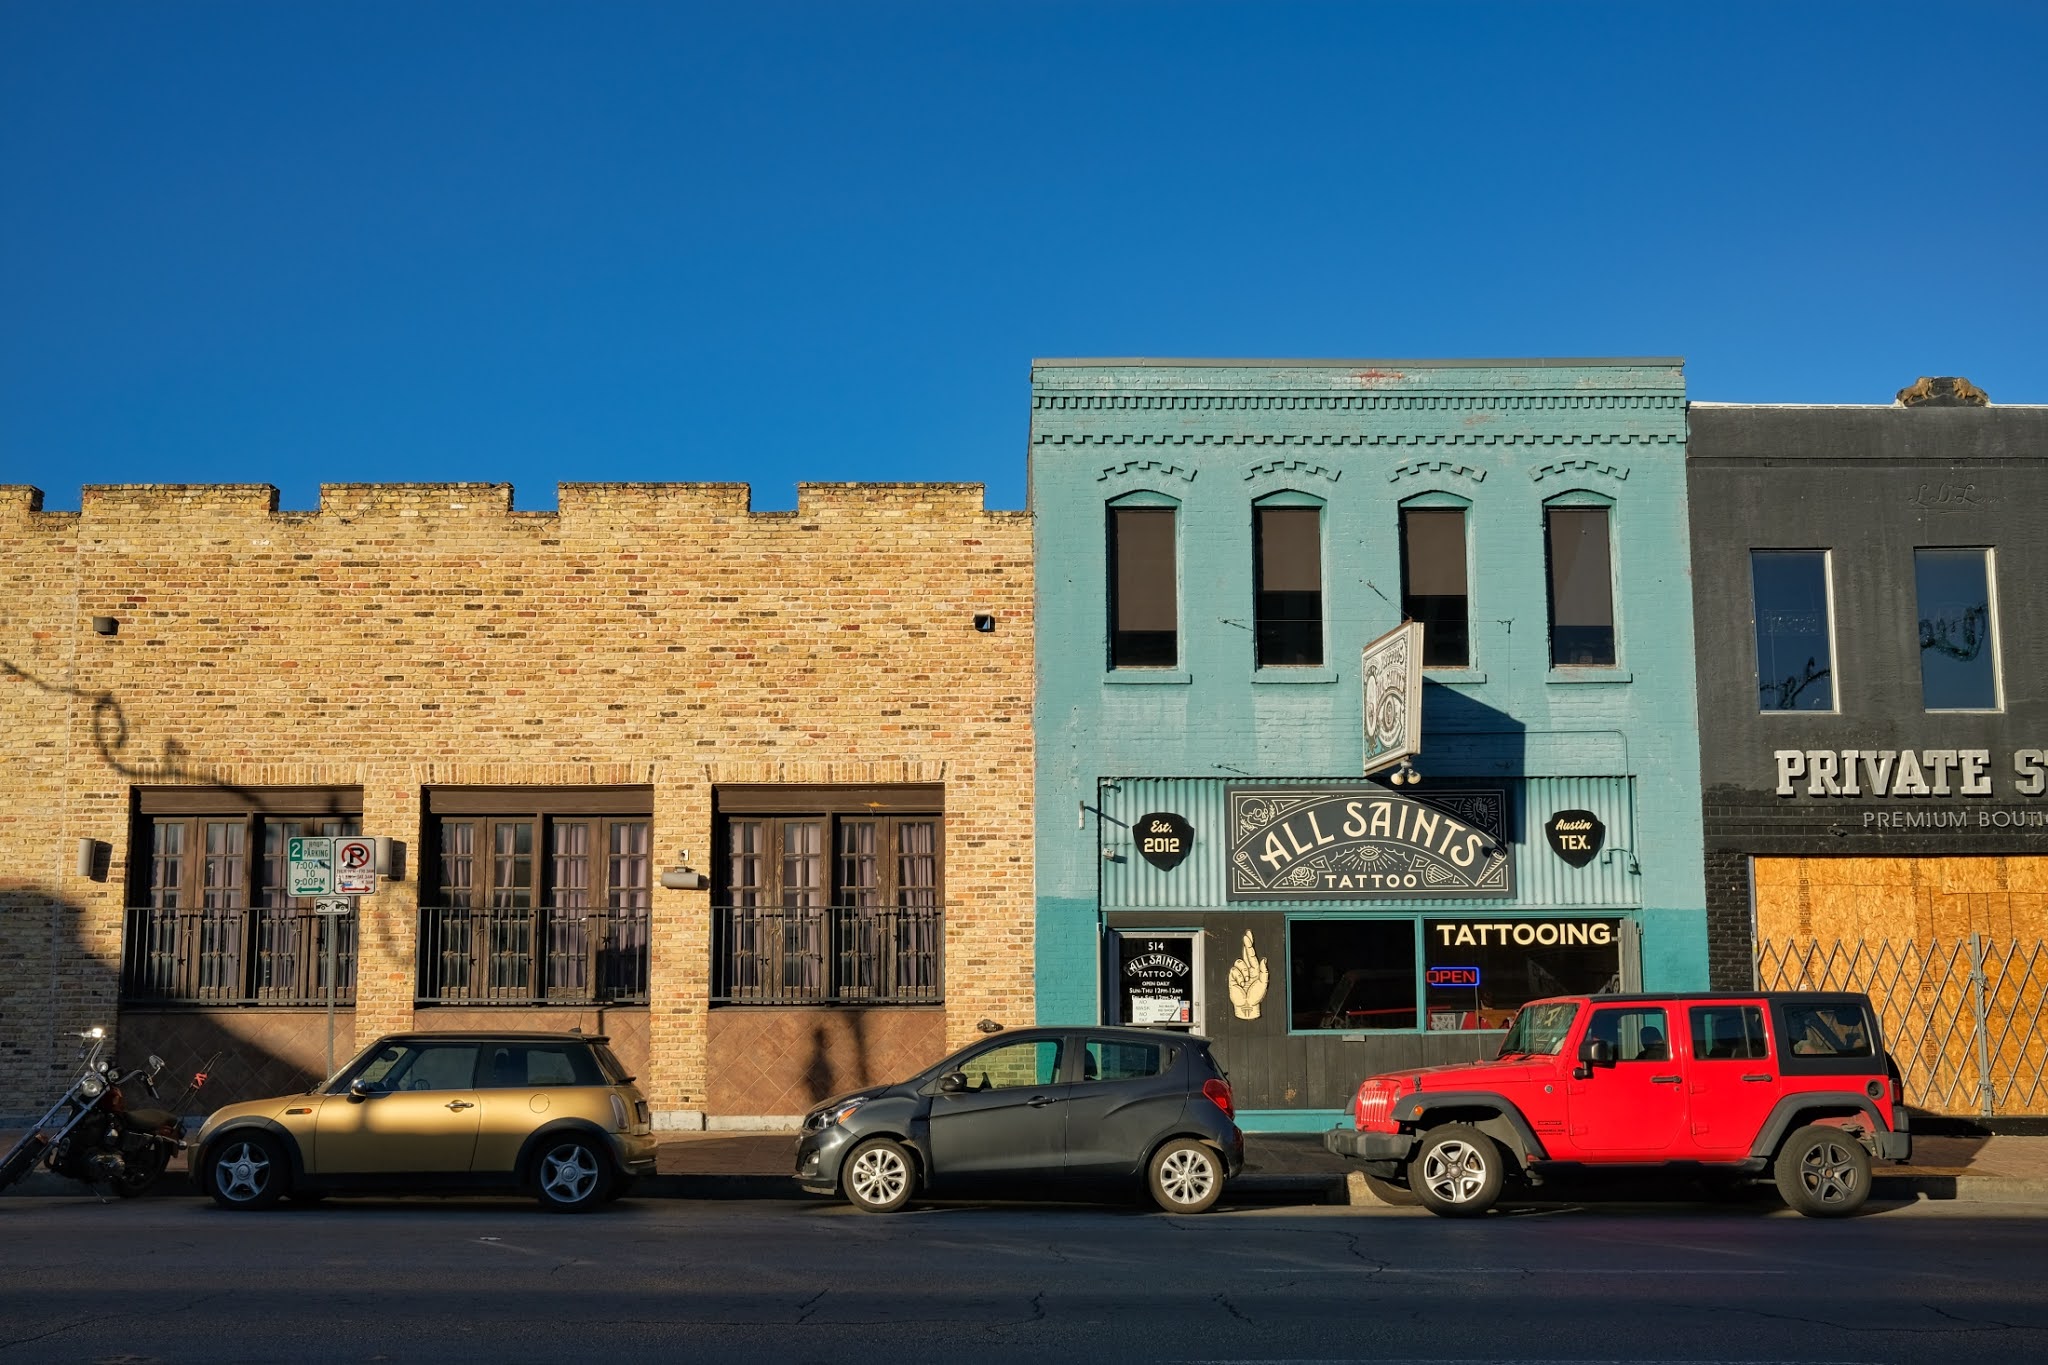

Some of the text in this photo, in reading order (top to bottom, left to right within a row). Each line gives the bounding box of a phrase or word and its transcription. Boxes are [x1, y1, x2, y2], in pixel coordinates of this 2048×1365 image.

[1774, 749, 2048, 795] PRIVATE S
[1150, 820, 1172, 833] Est.
[1555, 819, 1592, 830] Austin
[1863, 811, 2048, 828] PREMIUM BOUTI
[1259, 802, 1483, 871] ALL SAINTS
[1559, 835, 1591, 850] TEX.
[291, 842, 301, 858] 2
[1144, 838, 1179, 852] 2012
[304, 849, 328, 857] PARKING
[294, 878, 325, 886] 9:00PM
[1325, 874, 1417, 888] TATTOO
[1436, 923, 1611, 945] TATTOOING
[1148, 942, 1164, 950] 514
[1129, 955, 1184, 972] ALL SAINTS
[1426, 970, 1476, 983] OPEN
